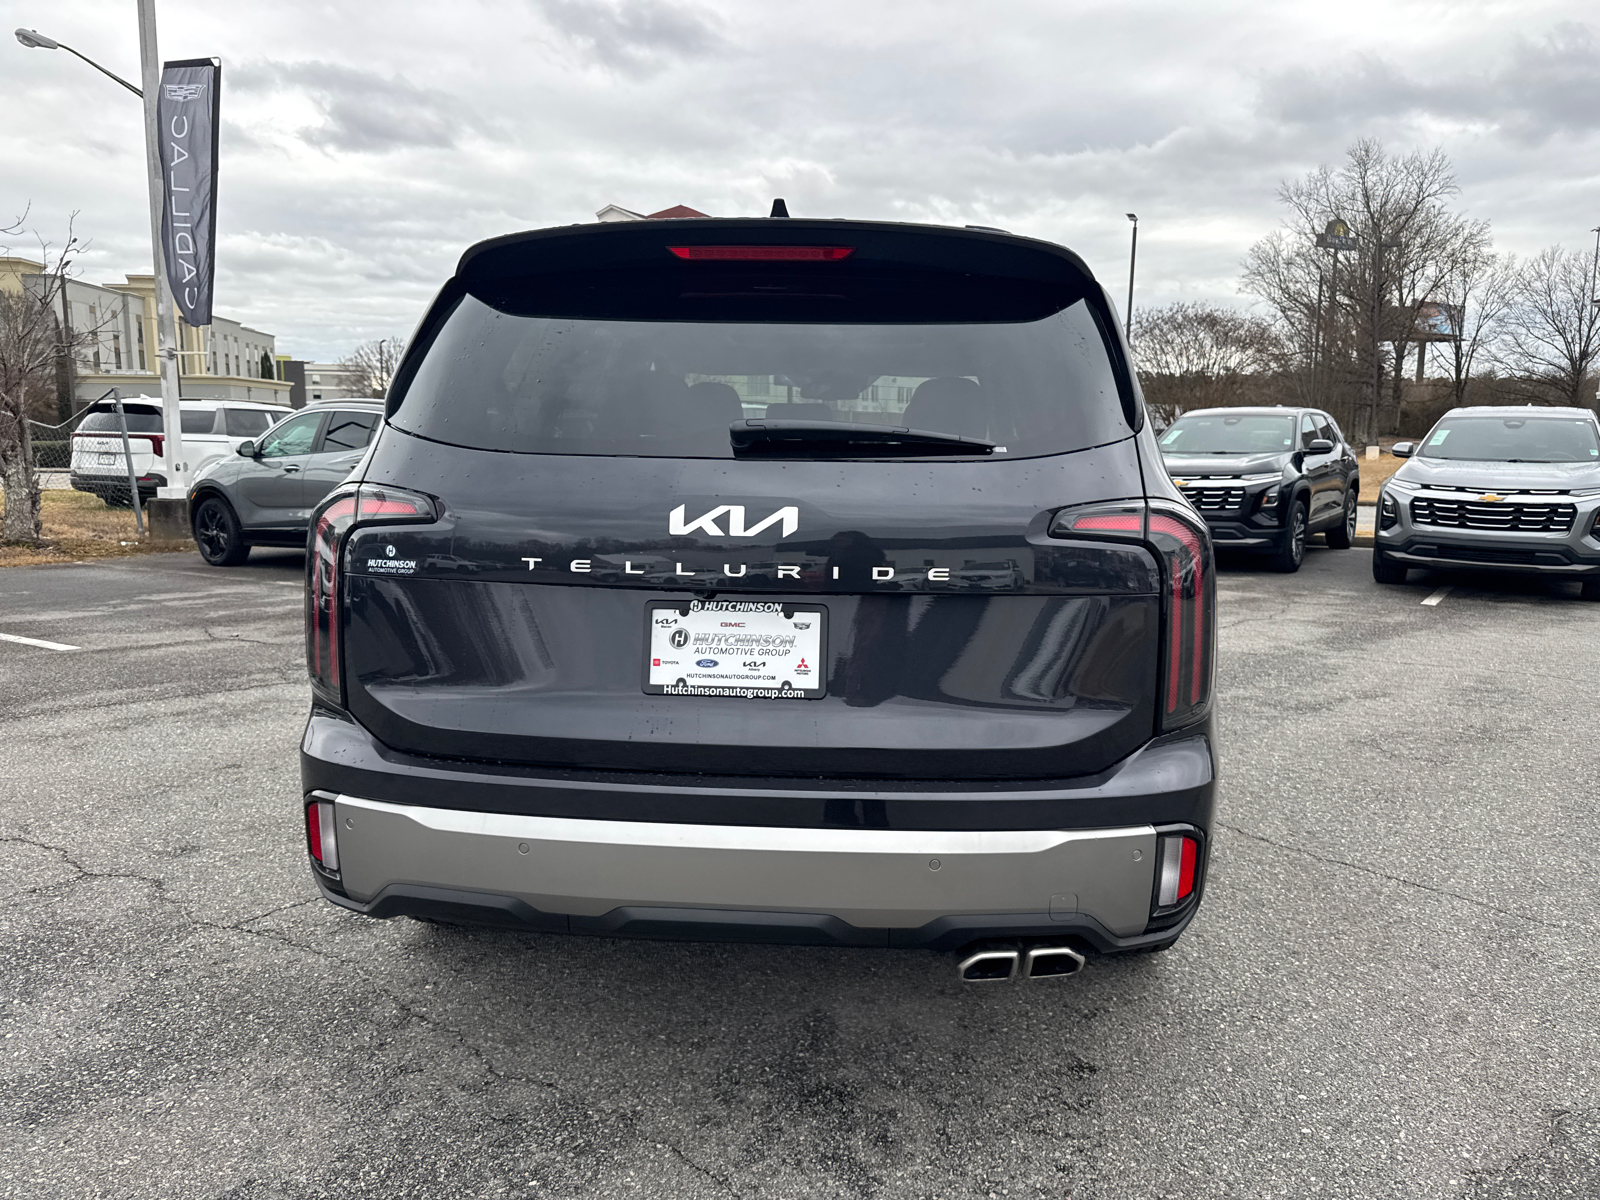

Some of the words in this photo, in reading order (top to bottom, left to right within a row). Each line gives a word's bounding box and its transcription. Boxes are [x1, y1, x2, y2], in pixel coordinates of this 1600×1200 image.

[669, 504, 799, 538] KIA
[367, 559, 416, 568] HUTCHINSON
[521, 557, 951, 582] TELLURIDE
[704, 601, 783, 613] HUTCHINSON
[692, 633, 797, 648] HUTCHINSON
[694, 647, 755, 656] AUTOMOTIVE
[757, 649, 791, 657] GROUP
[686, 673, 777, 681] HUTCHINSONAUTOGROUP.COM
[663, 685, 805, 699] Hutchinsonautogroup.com
